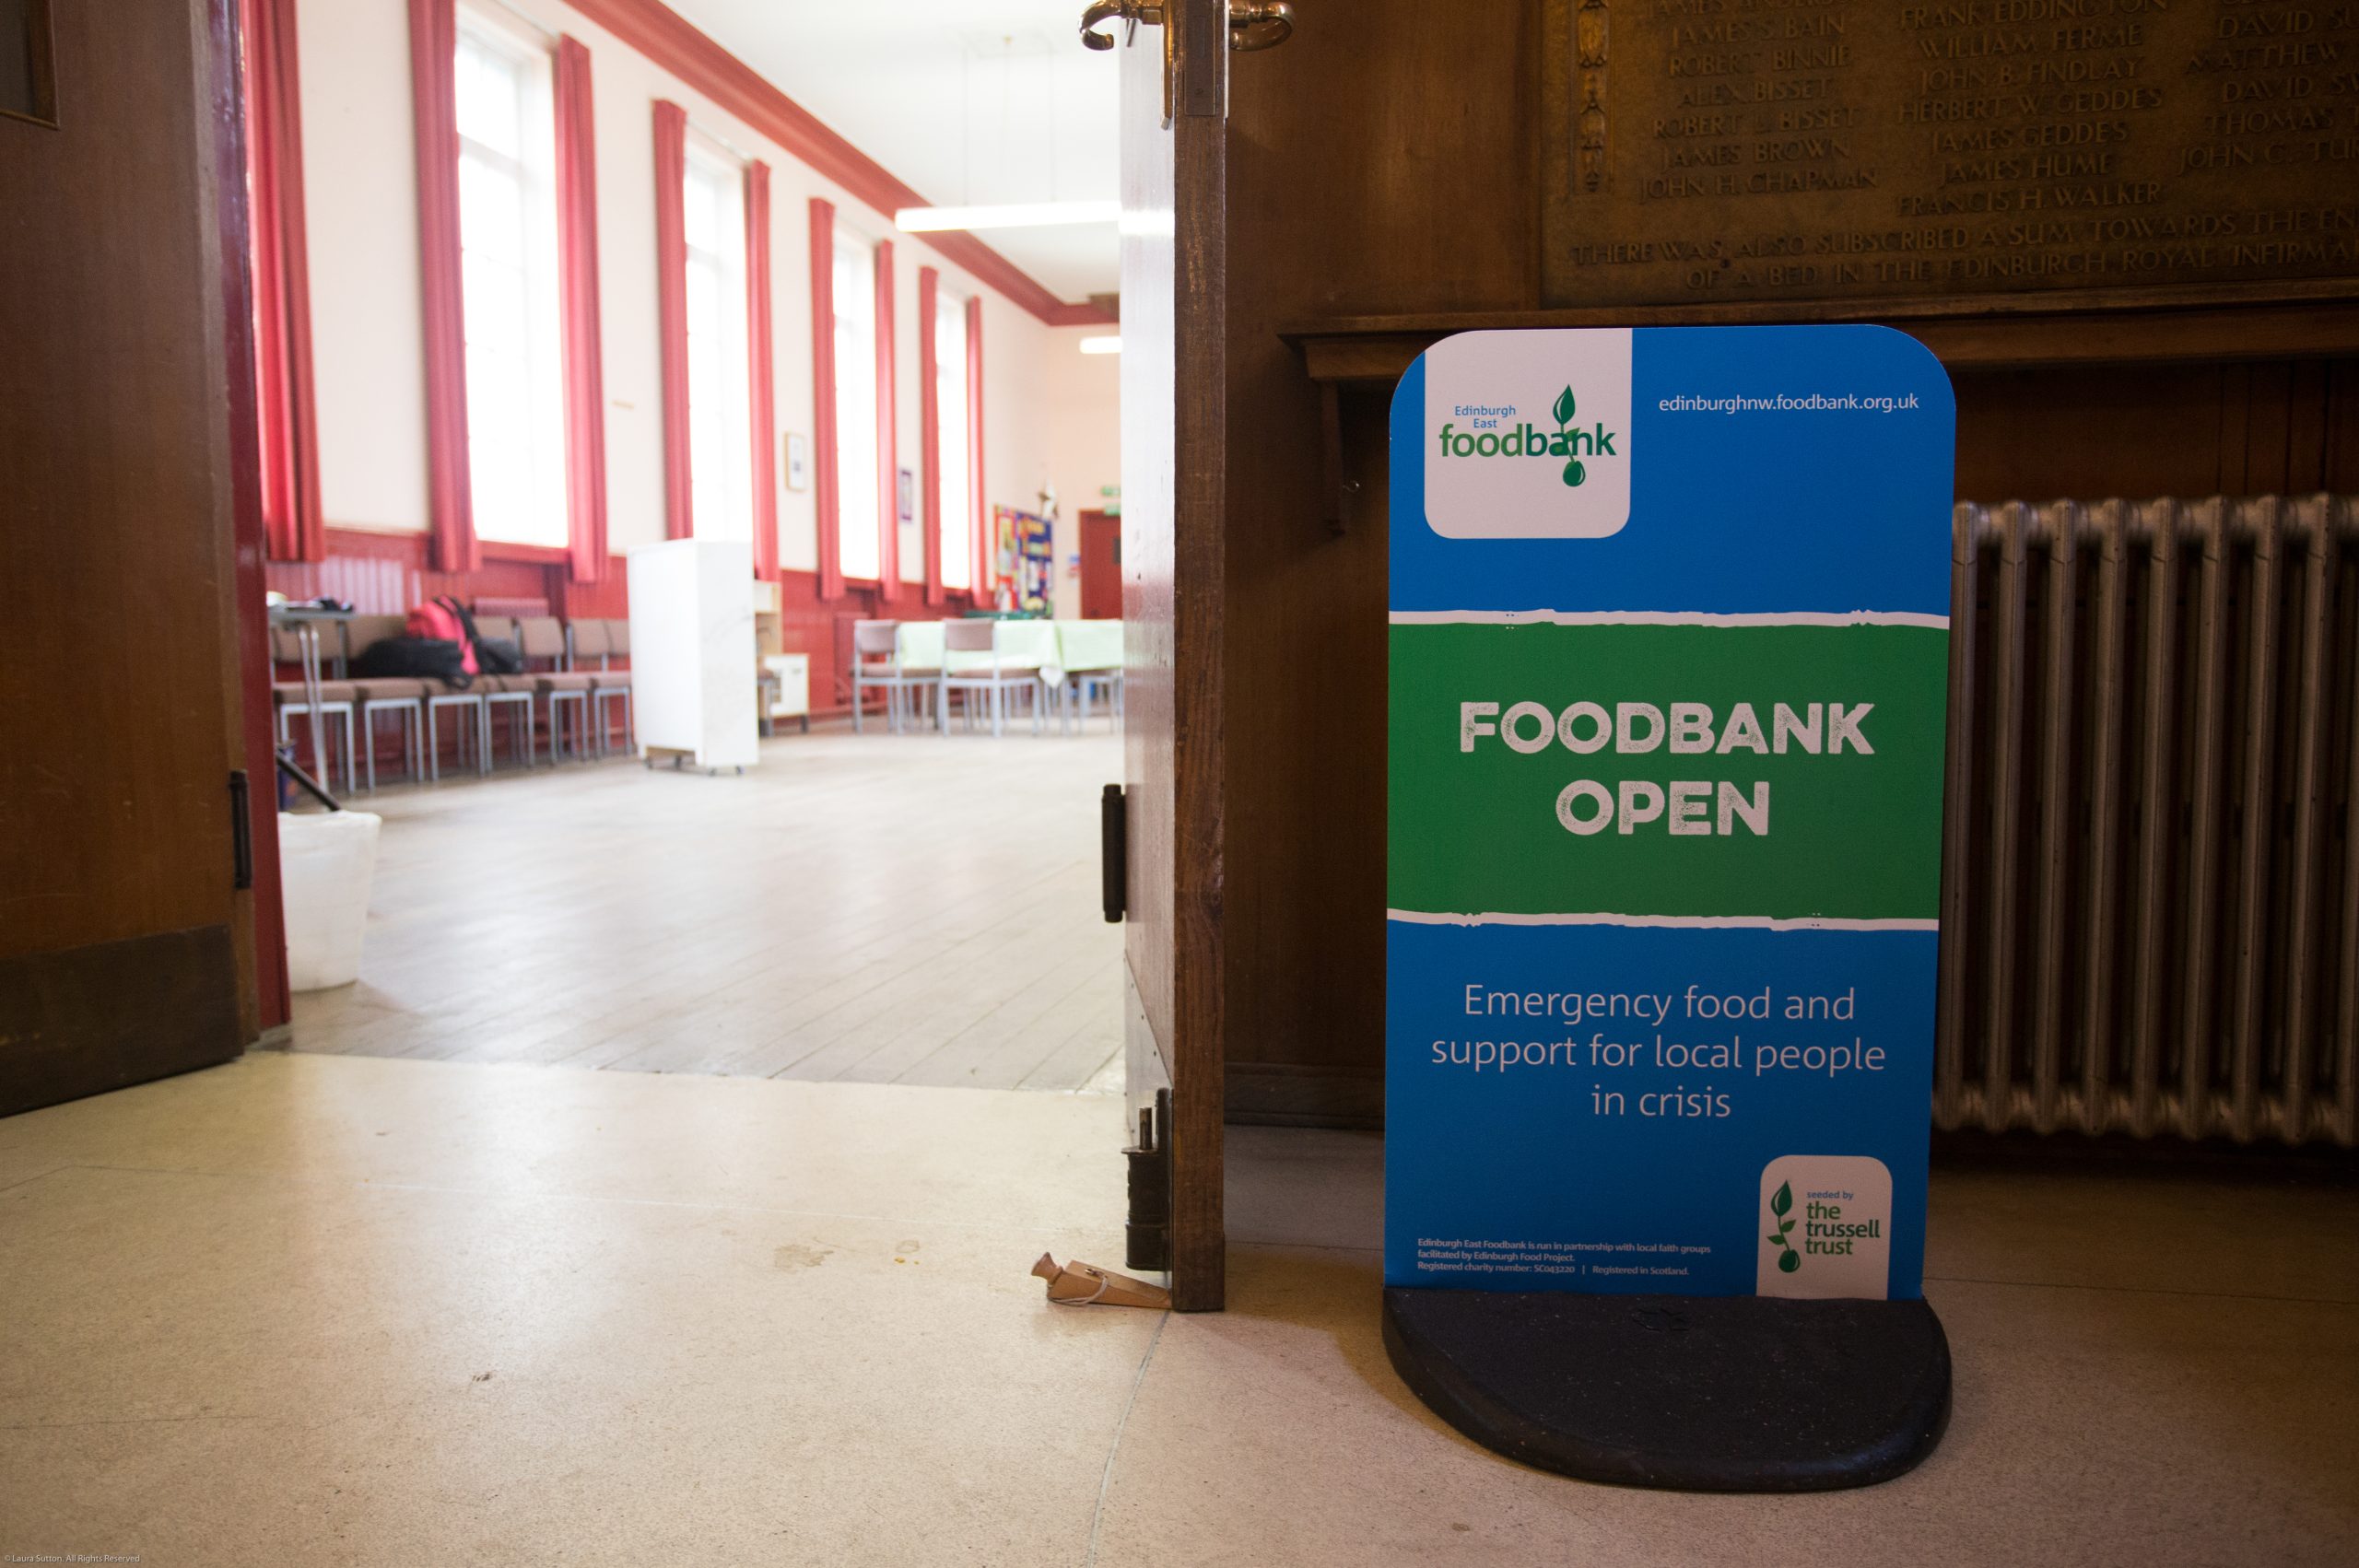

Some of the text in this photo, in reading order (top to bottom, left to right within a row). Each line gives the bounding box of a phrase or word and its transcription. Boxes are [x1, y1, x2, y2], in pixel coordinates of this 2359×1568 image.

[1672, 22, 1751, 48] JAMES
[1784, 14, 1844, 39] BAIN
[1900, 4, 1981, 29] FRANK
[2218, 10, 2315, 39] DAVID
[1919, 24, 2144, 59] WILLIAM FERME
[1670, 45, 1850, 77] ROBERT BINNIE
[2186, 42, 2345, 76] MATTHEW
[1754, 77, 1835, 102] BISSET
[1919, 65, 1987, 97] JOHN
[2027, 56, 2146, 84] FINDLAY
[2222, 76, 2314, 104] DAVID
[1897, 96, 2011, 124] HERBERT
[2055, 88, 2164, 114] GEDDES
[2205, 106, 2333, 135] THOMAS
[1653, 113, 1743, 139] ROBERT
[1778, 107, 1860, 132] BISSET
[1931, 121, 2129, 156] JAMES GEDDES
[1661, 137, 1850, 174] JAMES BROWN
[1937, 152, 2112, 190] JAMES HUME
[2177, 144, 2255, 177] JOHN
[1638, 175, 1704, 205] JOHN
[1748, 167, 1878, 194] CHAPMAN
[1897, 191, 2012, 217] FRANCIS
[2053, 182, 2163, 207] WALKER
[1571, 241, 1653, 266] THERE
[1660, 240, 1723, 262] WAS
[1733, 234, 1807, 259] ALSO
[1814, 228, 1969, 254] SUBSCRIBED
[1980, 226, 2000, 247] A
[2009, 223, 2074, 246] SUM
[2089, 214, 2236, 241] TOWARDS
[2248, 208, 2310, 234] THE
[1686, 269, 1720, 291] OF
[1732, 269, 1755, 289] A
[1769, 265, 1818, 287] BED
[1834, 263, 1860, 284] IN
[1875, 260, 1931, 283] THE
[1945, 251, 2107, 279] EDINBURGH
[2122, 246, 2214, 272] ROYAL
[1454, 405, 1516, 417] Edinburgh
[1658, 392, 1919, 415] edinburghnw.foodbank.org.uk
[1473, 418, 1497, 428] East
[1439, 422, 1616, 458] foodbank
[1460, 701, 1875, 755] FOODBANK
[1555, 779, 1769, 836] OPEN
[1464, 985, 1855, 1026] Emergency food and
[1431, 1034, 1885, 1078] support for local people
[1591, 1084, 1731, 1117] in crisis
[1806, 1200, 1841, 1220] the
[1842, 1190, 1854, 1200] by
[1805, 1219, 1881, 1238] trussell
[1417, 1238, 1462, 1251] Edinburgh
[1464, 1239, 1481, 1248] East
[1484, 1240, 1526, 1250] Foodbank
[1528, 1241, 1535, 1250] is
[1554, 1241, 1562, 1250] in
[1564, 1242, 1613, 1253] partnership
[1615, 1243, 1636, 1252] with
[1637, 1243, 1657, 1253] local
[1659, 1243, 1679, 1253] faith
[1680, 1246, 1711, 1255] groups
[1417, 1249, 1575, 1263] facilitated by Edinburgh Food Project.
[1804, 1238, 1853, 1255] trust
[1417, 1261, 1462, 1272] Registered
[1464, 1262, 1493, 1273] charity
[1496, 1263, 1532, 1272] number:
[1592, 1265, 1638, 1276] Registered
[1640, 1266, 1649, 1275] in
[1649, 1266, 1689, 1276] Scotland.
